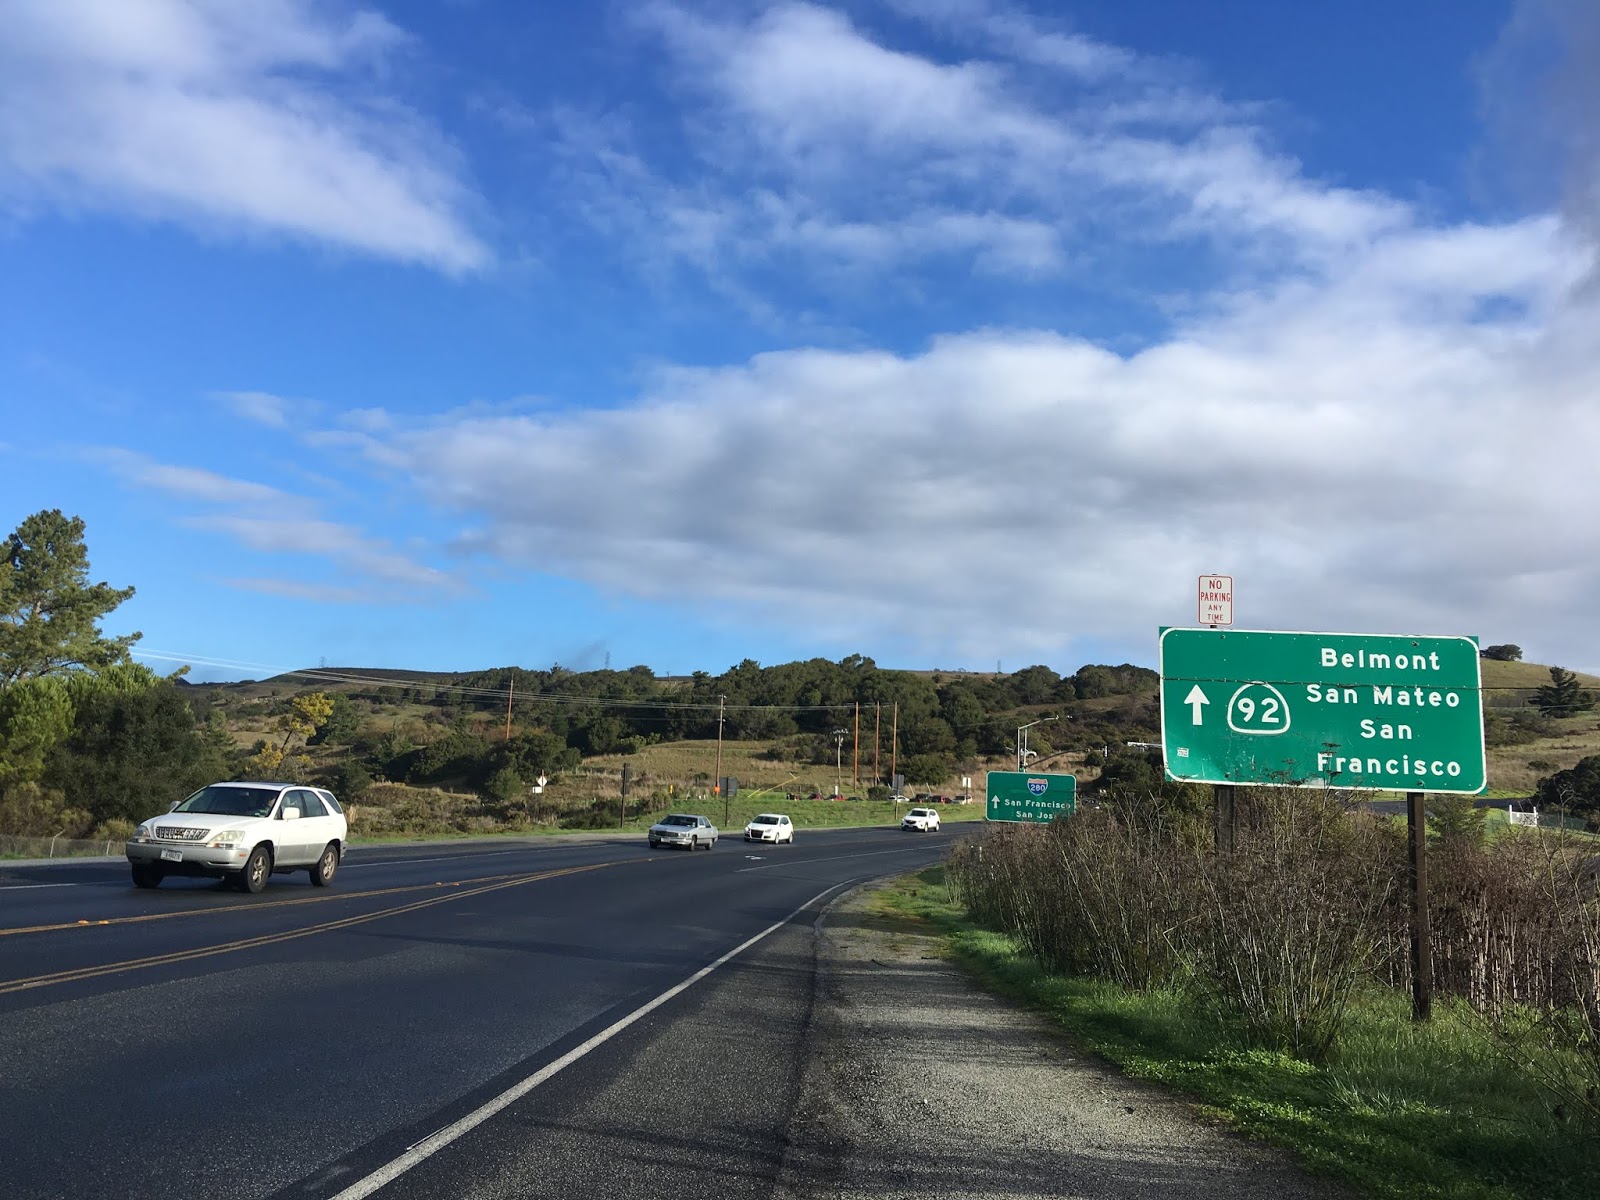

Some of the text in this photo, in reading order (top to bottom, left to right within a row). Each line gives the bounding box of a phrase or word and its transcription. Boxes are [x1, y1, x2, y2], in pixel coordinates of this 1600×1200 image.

[1209, 579, 1222, 590] NO
[1200, 591, 1231, 602] PARKING
[1207, 613, 1224, 621] TIME
[1320, 647, 1441, 671] Belmont
[1306, 683, 1460, 708] San Mateo
[1237, 697, 1280, 724] 92
[1360, 719, 1413, 740] San
[1317, 752, 1462, 777] Francisco
[1030, 784, 1046, 792] 280
[1004, 798, 1071, 809] San Francisco
[1016, 810, 1057, 820] San Jos
